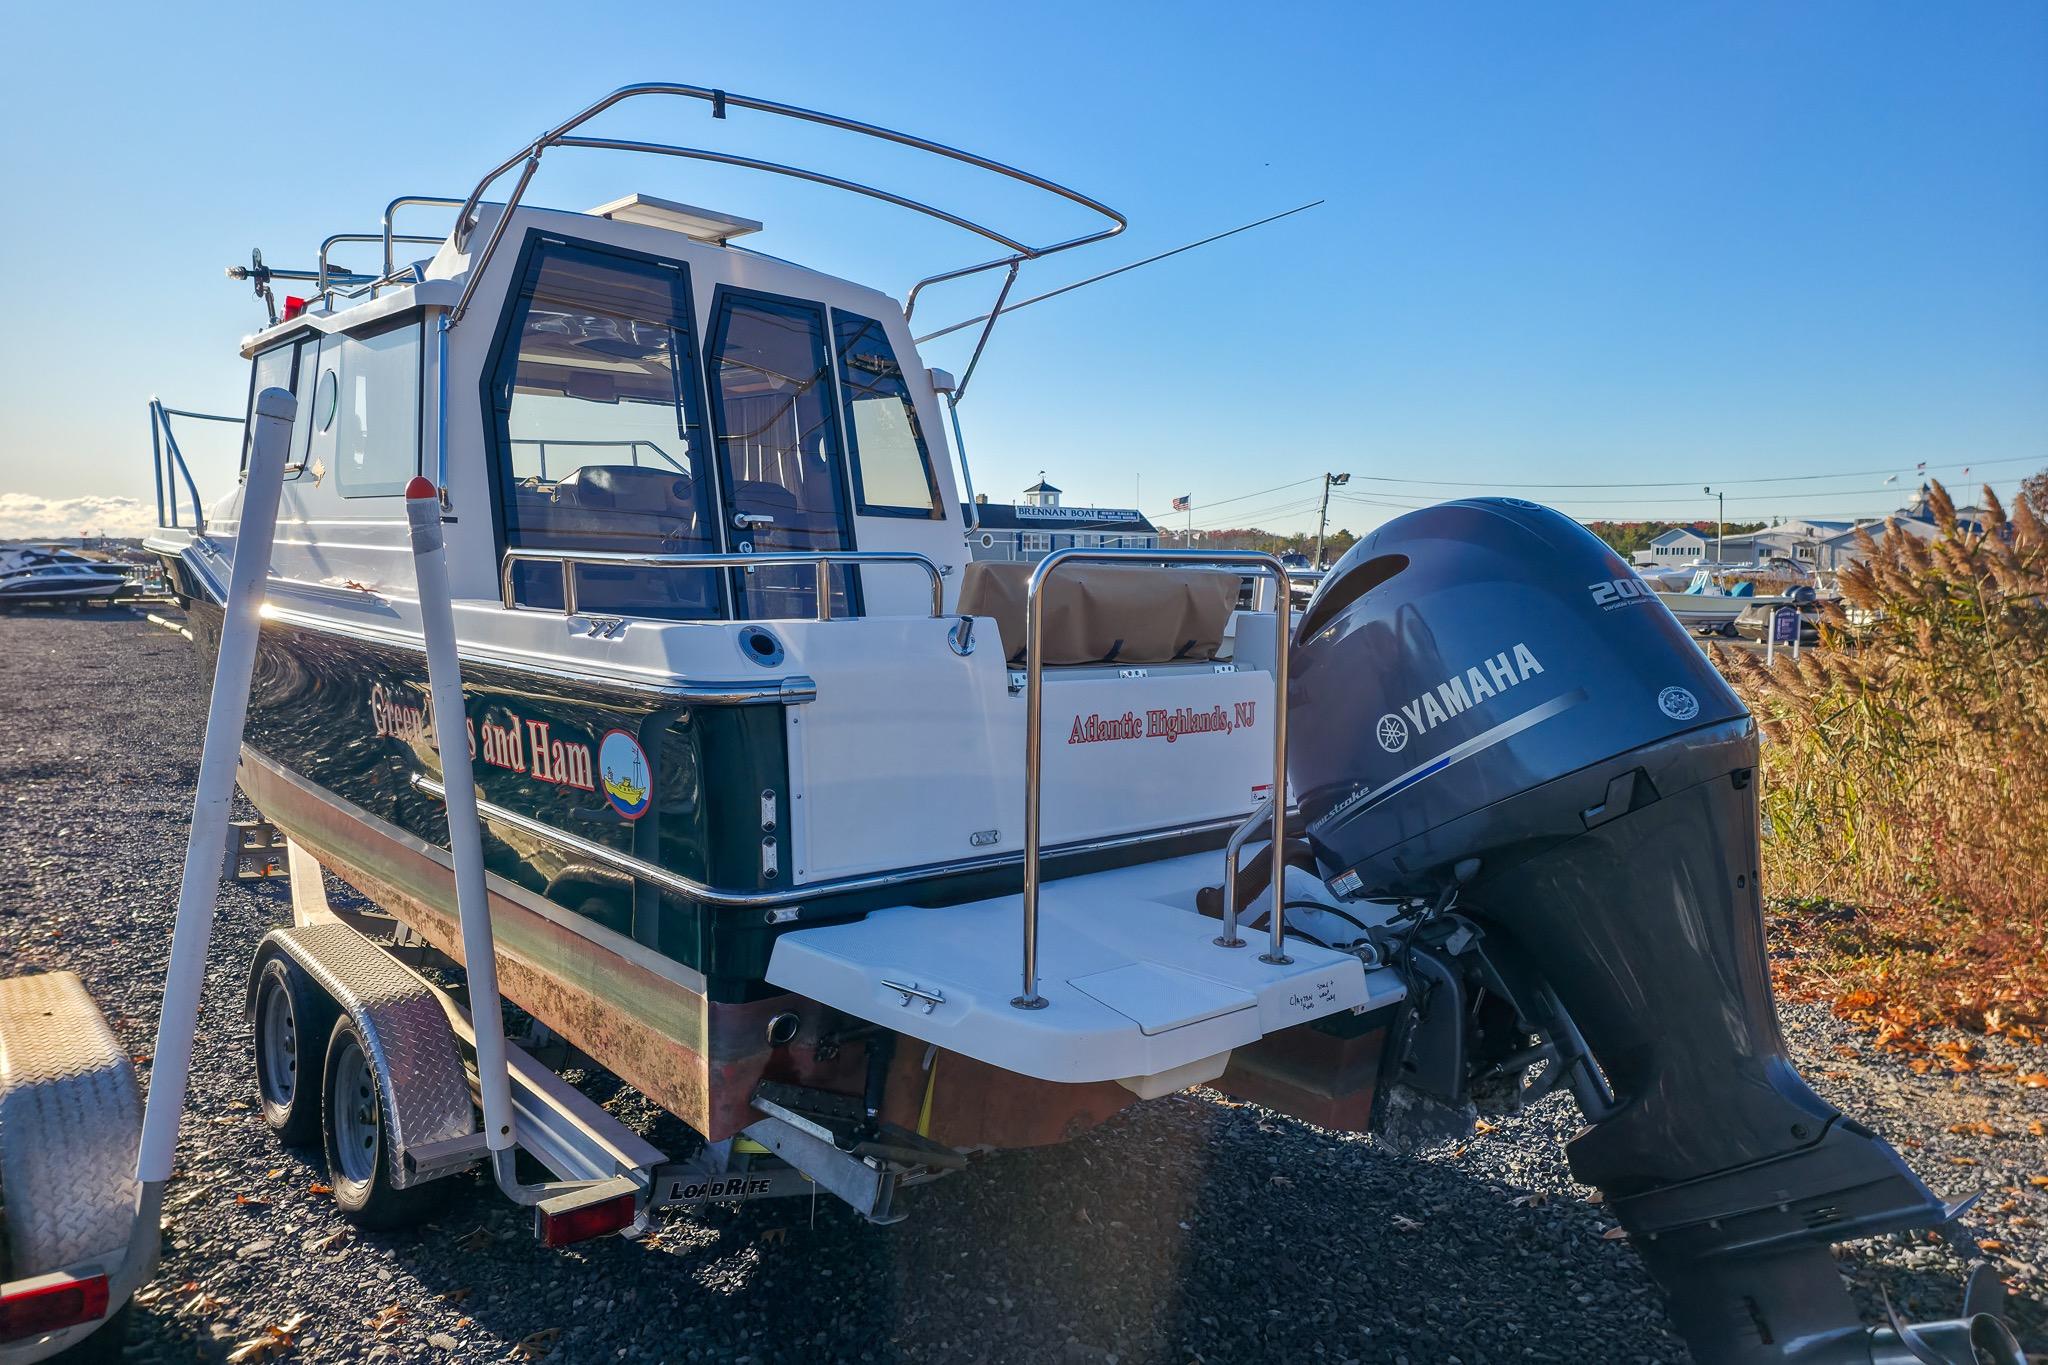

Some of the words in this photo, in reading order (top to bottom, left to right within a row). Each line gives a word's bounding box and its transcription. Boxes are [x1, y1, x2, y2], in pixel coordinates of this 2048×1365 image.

[1018, 507, 1067, 517] BRENNAN
[1071, 509, 1096, 518] BOAT
[1588, 578, 1654, 606] 200
[1401, 642, 1545, 736] YAMAHA
[372, 685, 424, 742] Green
[482, 714, 525, 773] and
[526, 719, 595, 792] Ham
[1068, 712, 1143, 744] Atlantic
[1146, 705, 1233, 743] Highlands,
[1234, 702, 1256, 729] NJ
